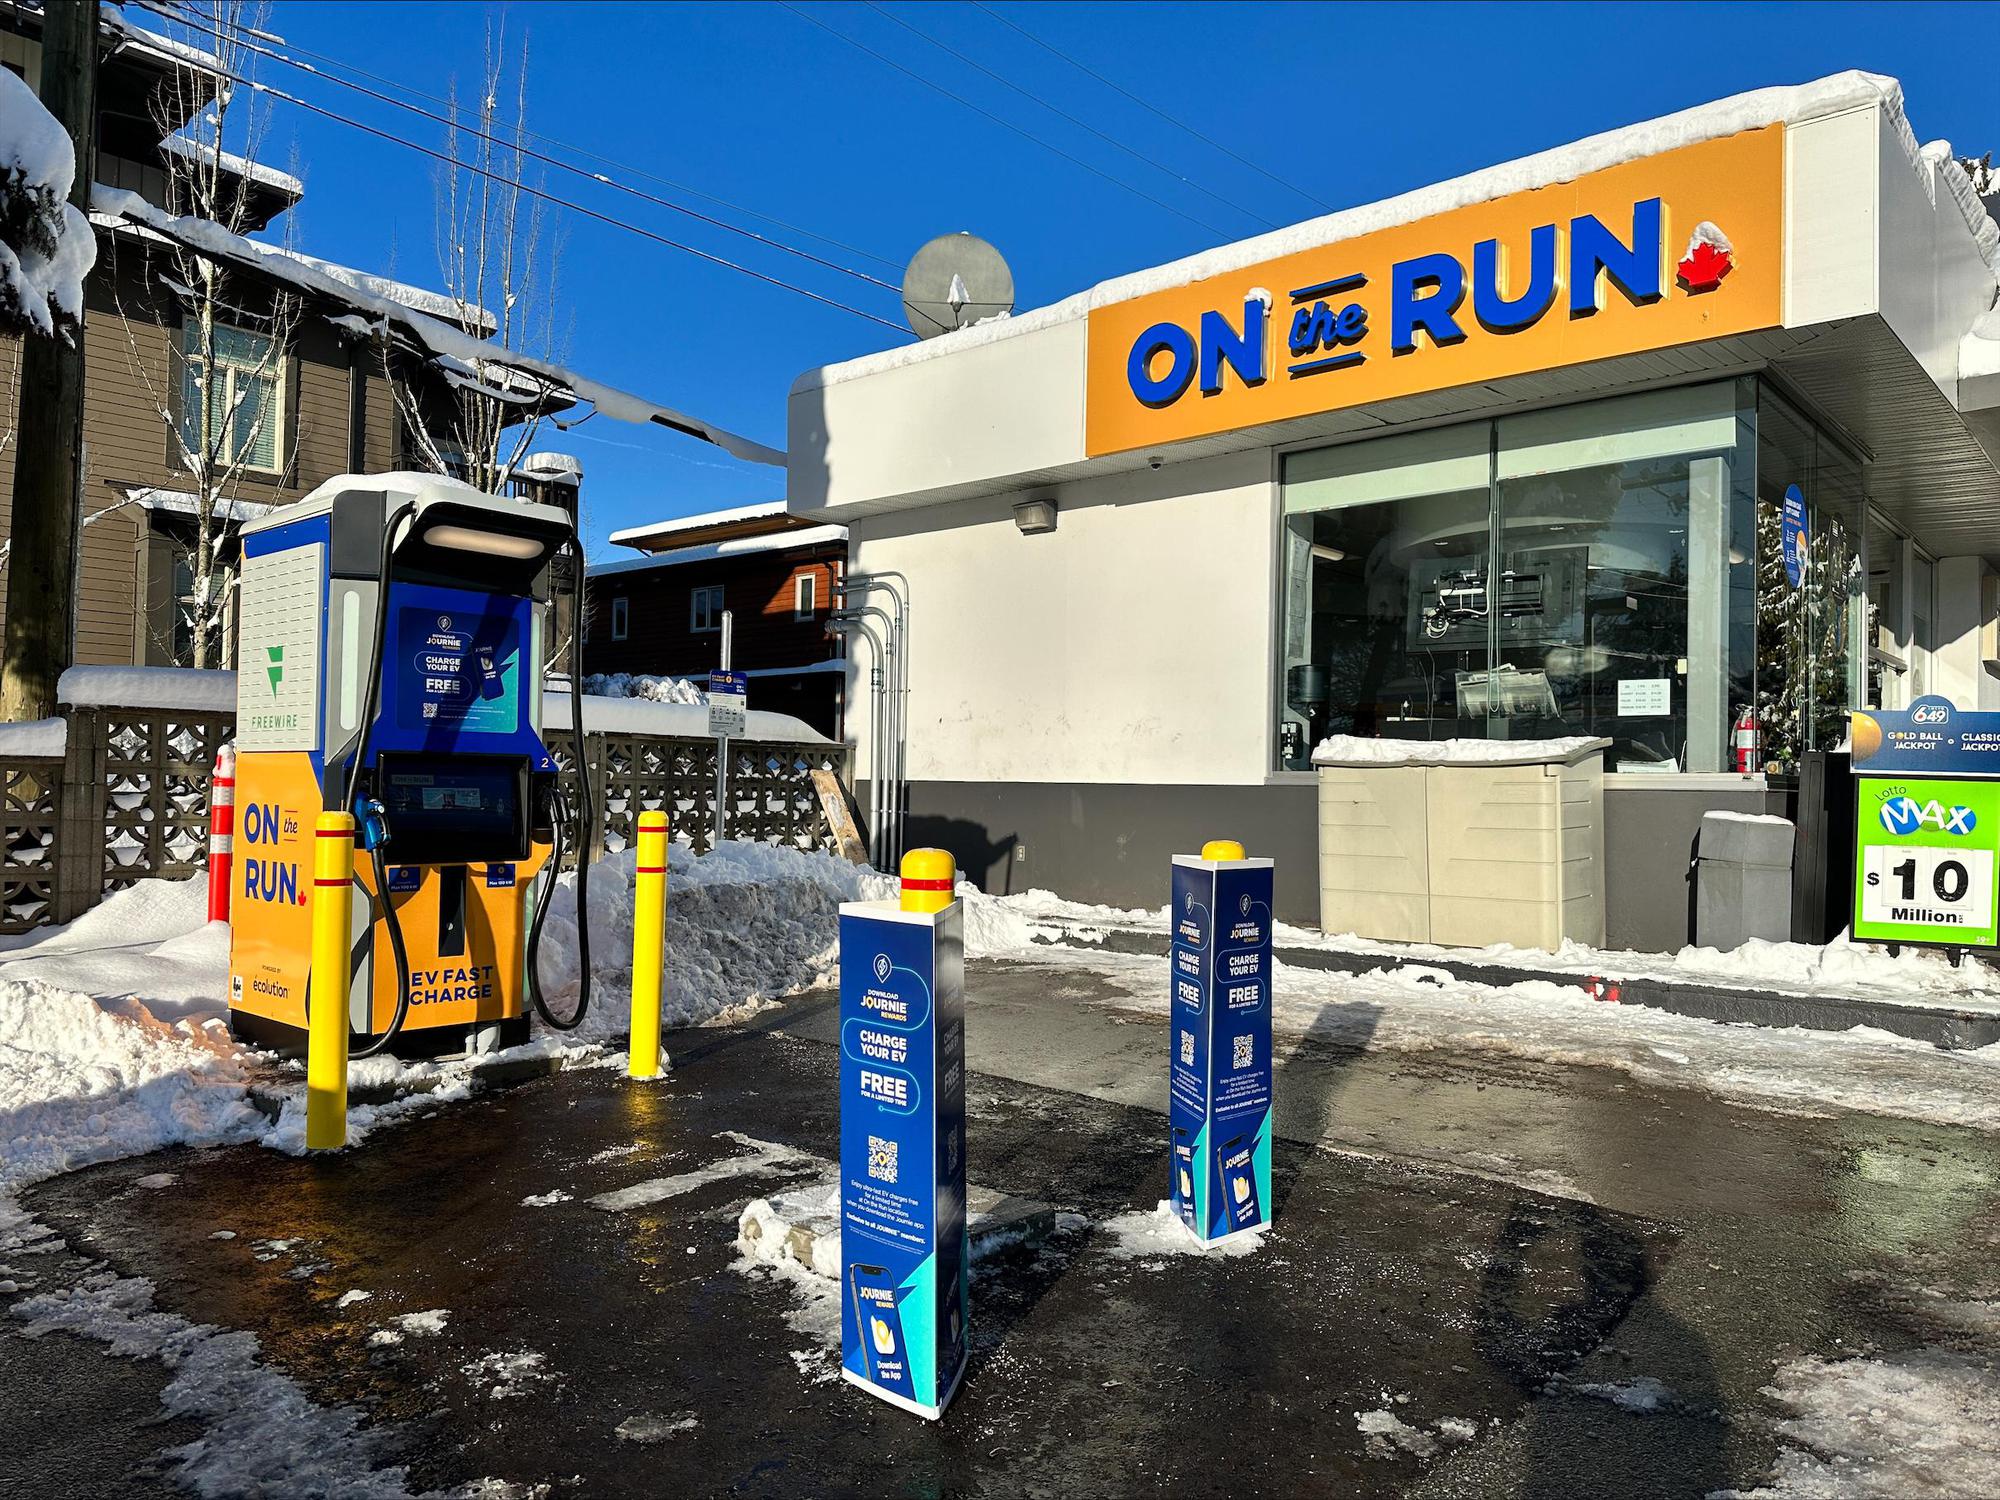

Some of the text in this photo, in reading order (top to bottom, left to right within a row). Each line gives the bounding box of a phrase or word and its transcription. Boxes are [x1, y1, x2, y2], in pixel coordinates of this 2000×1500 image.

[1127, 197, 1663, 407] ON the RUN
[426, 638, 461, 646] JOURNIE
[426, 656, 461, 666] CHARGE
[426, 678, 460, 690] FREE
[251, 713, 298, 730] FREEWIRE
[1888, 732, 1916, 740] GOLD
[1961, 743, 2000, 751] JACKPO
[541, 757, 549, 768] 2
[1874, 786, 1907, 802] Lotto
[1880, 796, 1972, 835] MAX
[244, 802, 298, 846] ON the
[245, 858, 297, 906] RUN
[1866, 858, 1969, 902] $ 10
[1892, 908, 1958, 922] Million
[1230, 927, 1259, 939] JOURNIE
[1178, 951, 1199, 966] CHARGE
[1229, 954, 1259, 966] CHARGE
[411, 965, 494, 987] EV FAST
[1179, 960, 1199, 976] YOUR EV
[1230, 964, 1258, 976] YOUR EV
[253, 974, 288, 999] écolution
[409, 983, 492, 1006] CHARGE
[868, 989, 898, 1000] DOWNLOAD
[1178, 981, 1199, 1003] FREE
[1229, 985, 1258, 1003] FREE
[860, 995, 907, 1014] JOURNIE
[880, 1011, 907, 1022] REWARDS
[860, 1030, 907, 1050] CHARGE
[861, 1043, 907, 1063] YOUR EV
[860, 1070, 907, 1098] FREE
[860, 1286, 894, 1301] JOURNIE
[877, 1360, 902, 1370] Download
[881, 1370, 901, 1380] the App
